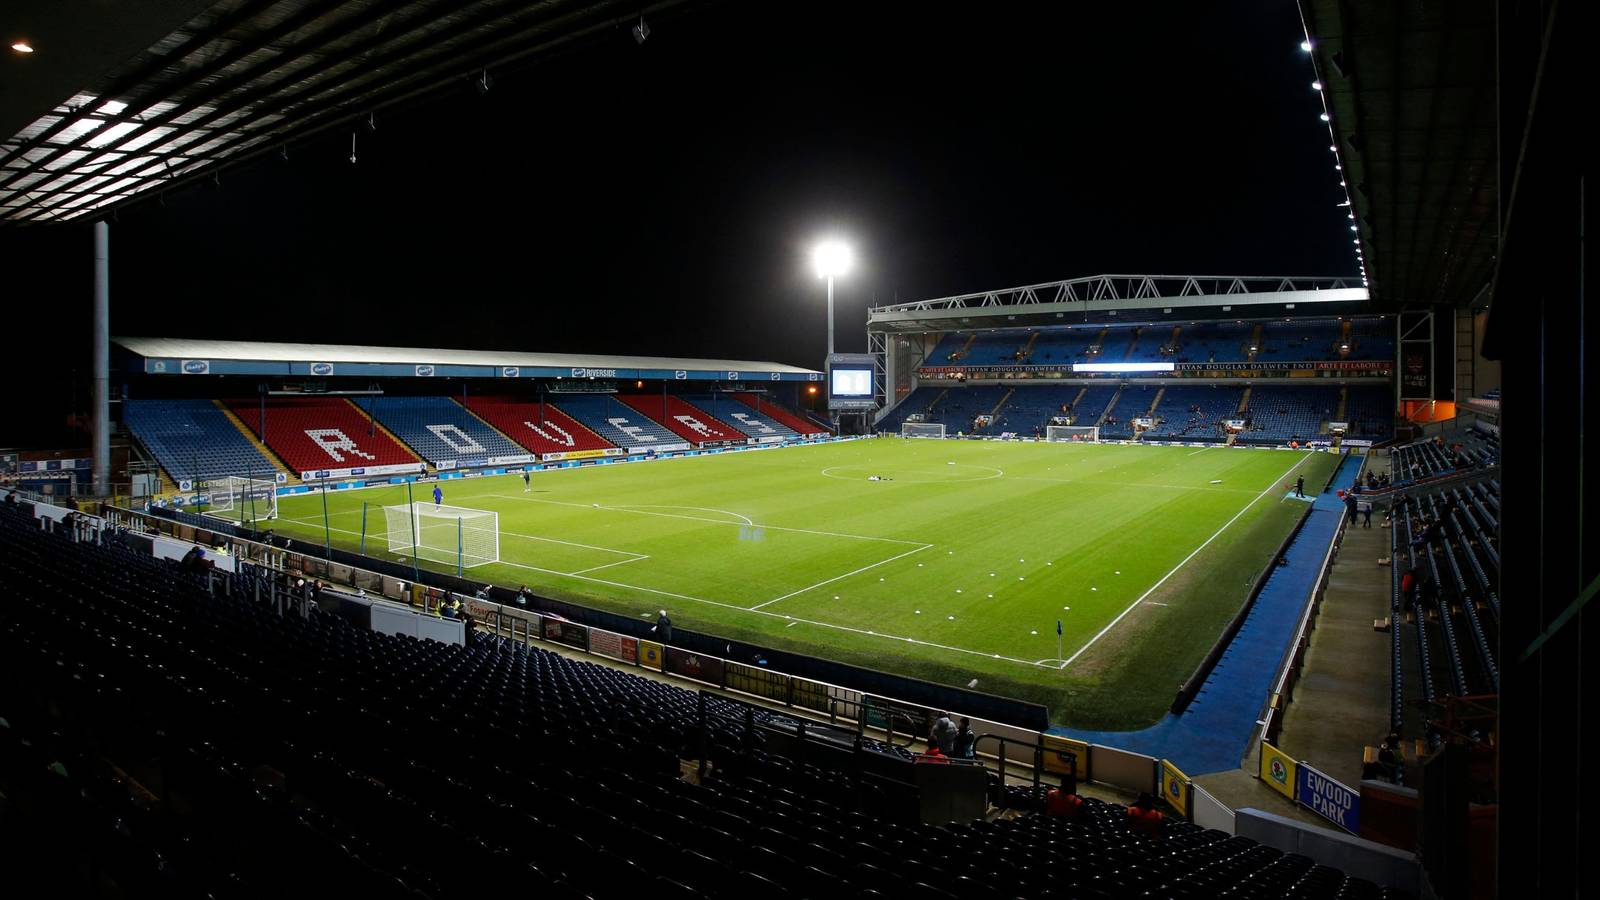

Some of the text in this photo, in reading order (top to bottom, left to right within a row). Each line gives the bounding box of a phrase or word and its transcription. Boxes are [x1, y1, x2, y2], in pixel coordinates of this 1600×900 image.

[587, 369, 616, 377] RIVERSIDE
[1307, 772, 1352, 810] EWOOD
[1313, 793, 1345, 825] PARK
